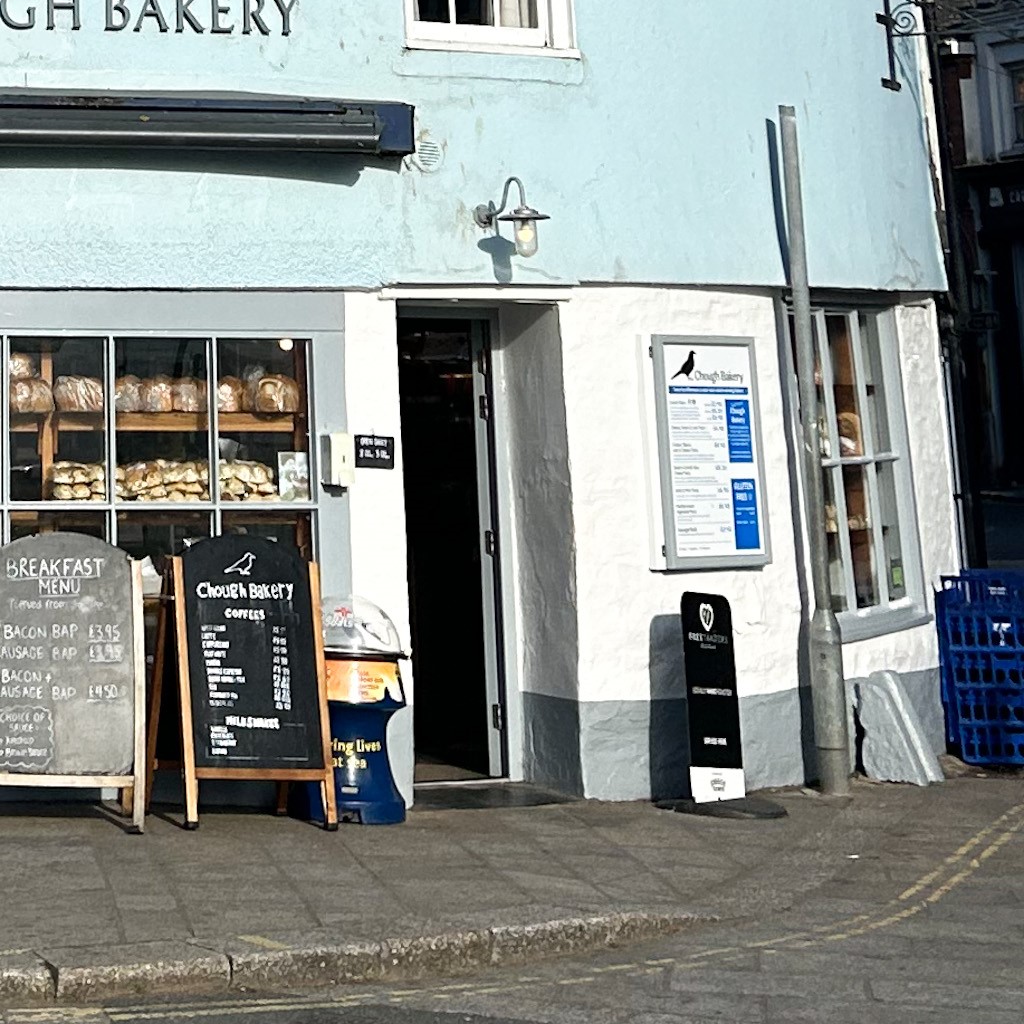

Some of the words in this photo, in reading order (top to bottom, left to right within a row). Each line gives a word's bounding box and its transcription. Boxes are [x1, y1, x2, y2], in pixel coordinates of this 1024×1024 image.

[694, 370, 720, 384] Chough
[720, 370, 744, 384] Bakery
[6, 557, 105, 578] BREAKFAST
[38, 578, 82, 596] MENU
[196, 581, 247, 600] Chough
[249, 582, 294, 601] Bakery
[224, 608, 266, 621] COFFEES
[4, 624, 47, 640] BACON
[52, 623, 79, 640] BAP
[52, 646, 78, 661] BAP
[1, 668, 44, 684] BACON
[51, 685, 77, 701] BAP
[0, 712, 30, 723] CHOICE
[356, 738, 382, 752] Lives
